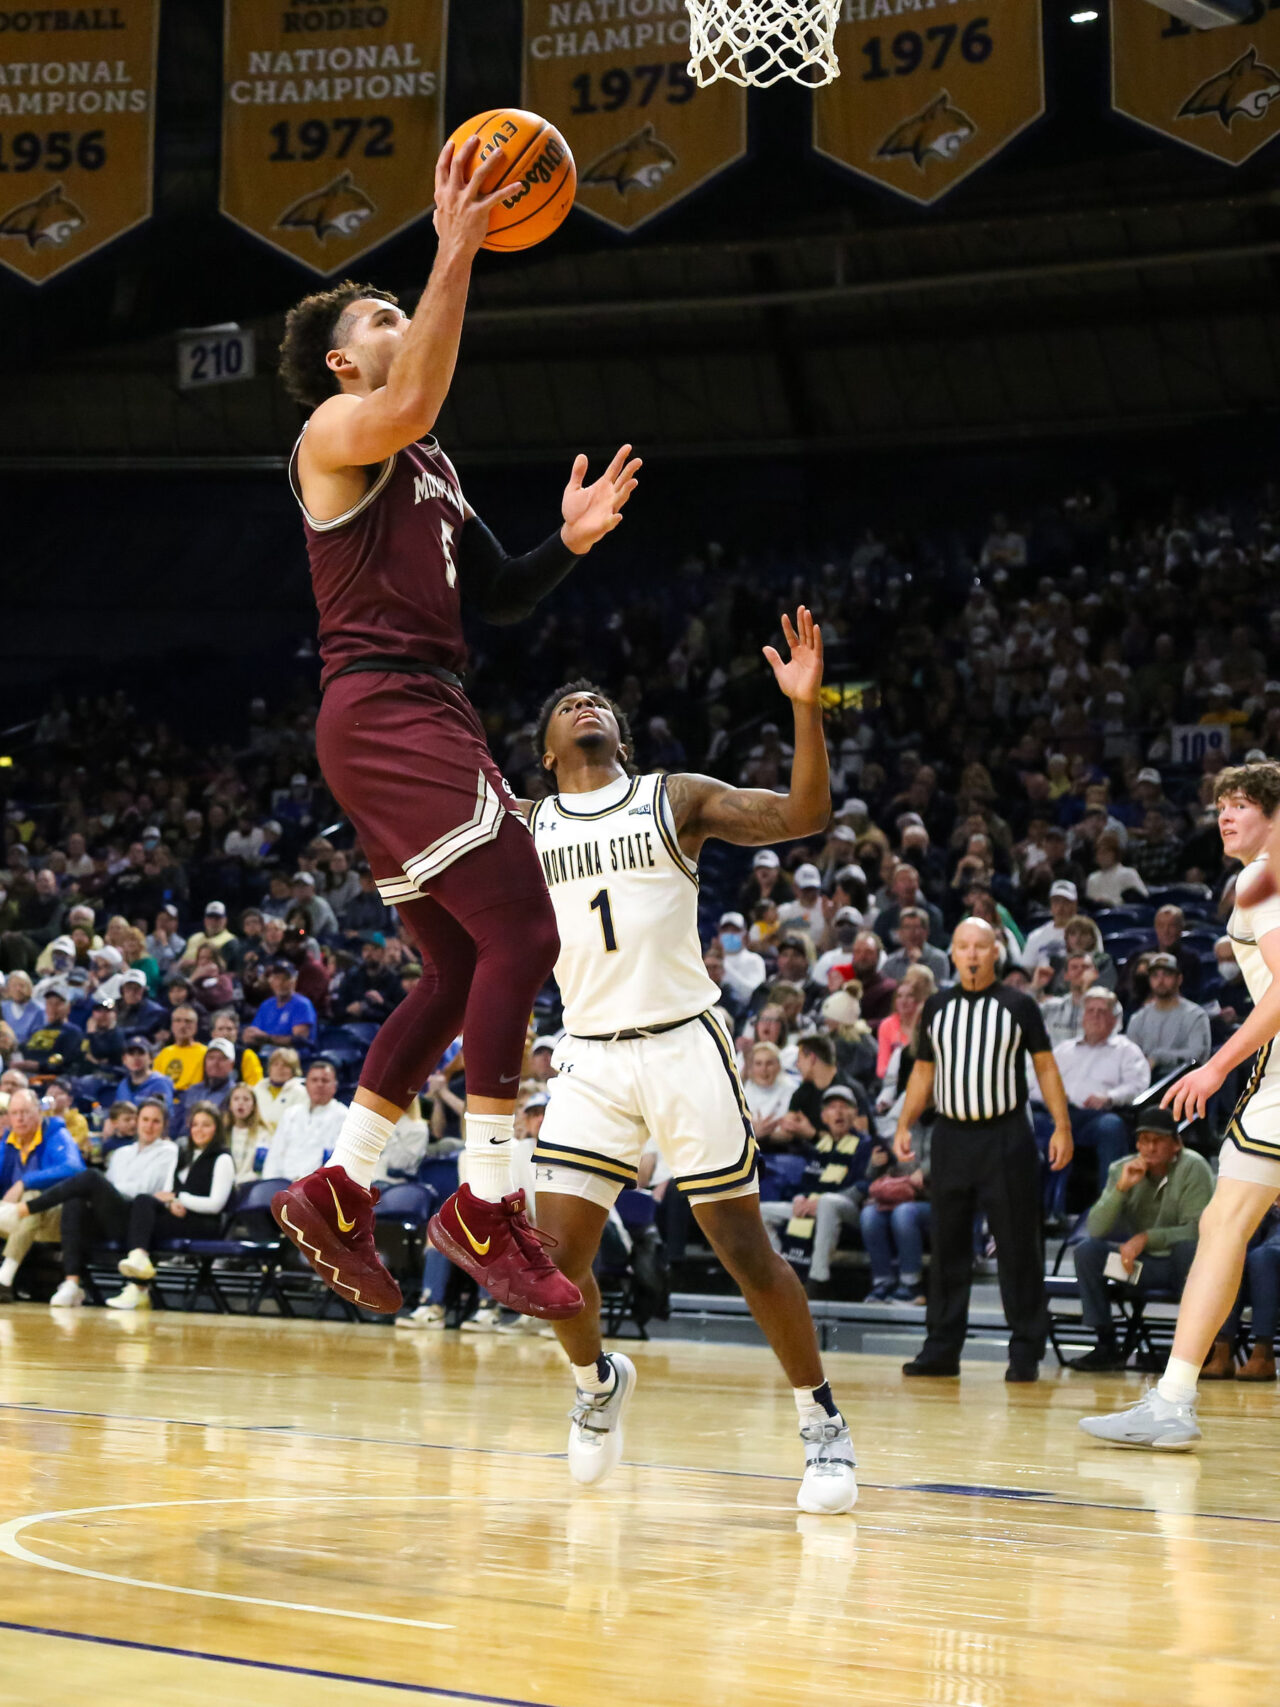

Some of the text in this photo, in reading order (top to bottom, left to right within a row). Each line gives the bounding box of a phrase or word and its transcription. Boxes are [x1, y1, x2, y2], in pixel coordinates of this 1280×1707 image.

[283, 7, 388, 33] RODEO
[549, 0, 688, 27] NATIO
[248, 42, 421, 75] NATIONAL
[530, 18, 691, 60] CHAMPIO
[861, 17, 993, 81] 1976
[229, 71, 437, 105] CHAMPIONS
[572, 61, 696, 115] 1975
[269, 116, 395, 162] 1972
[191, 339, 242, 379] 210
[440, 517, 457, 589] 5
[542, 831, 655, 887] MONTANA STATE
[589, 887, 619, 954] 1
